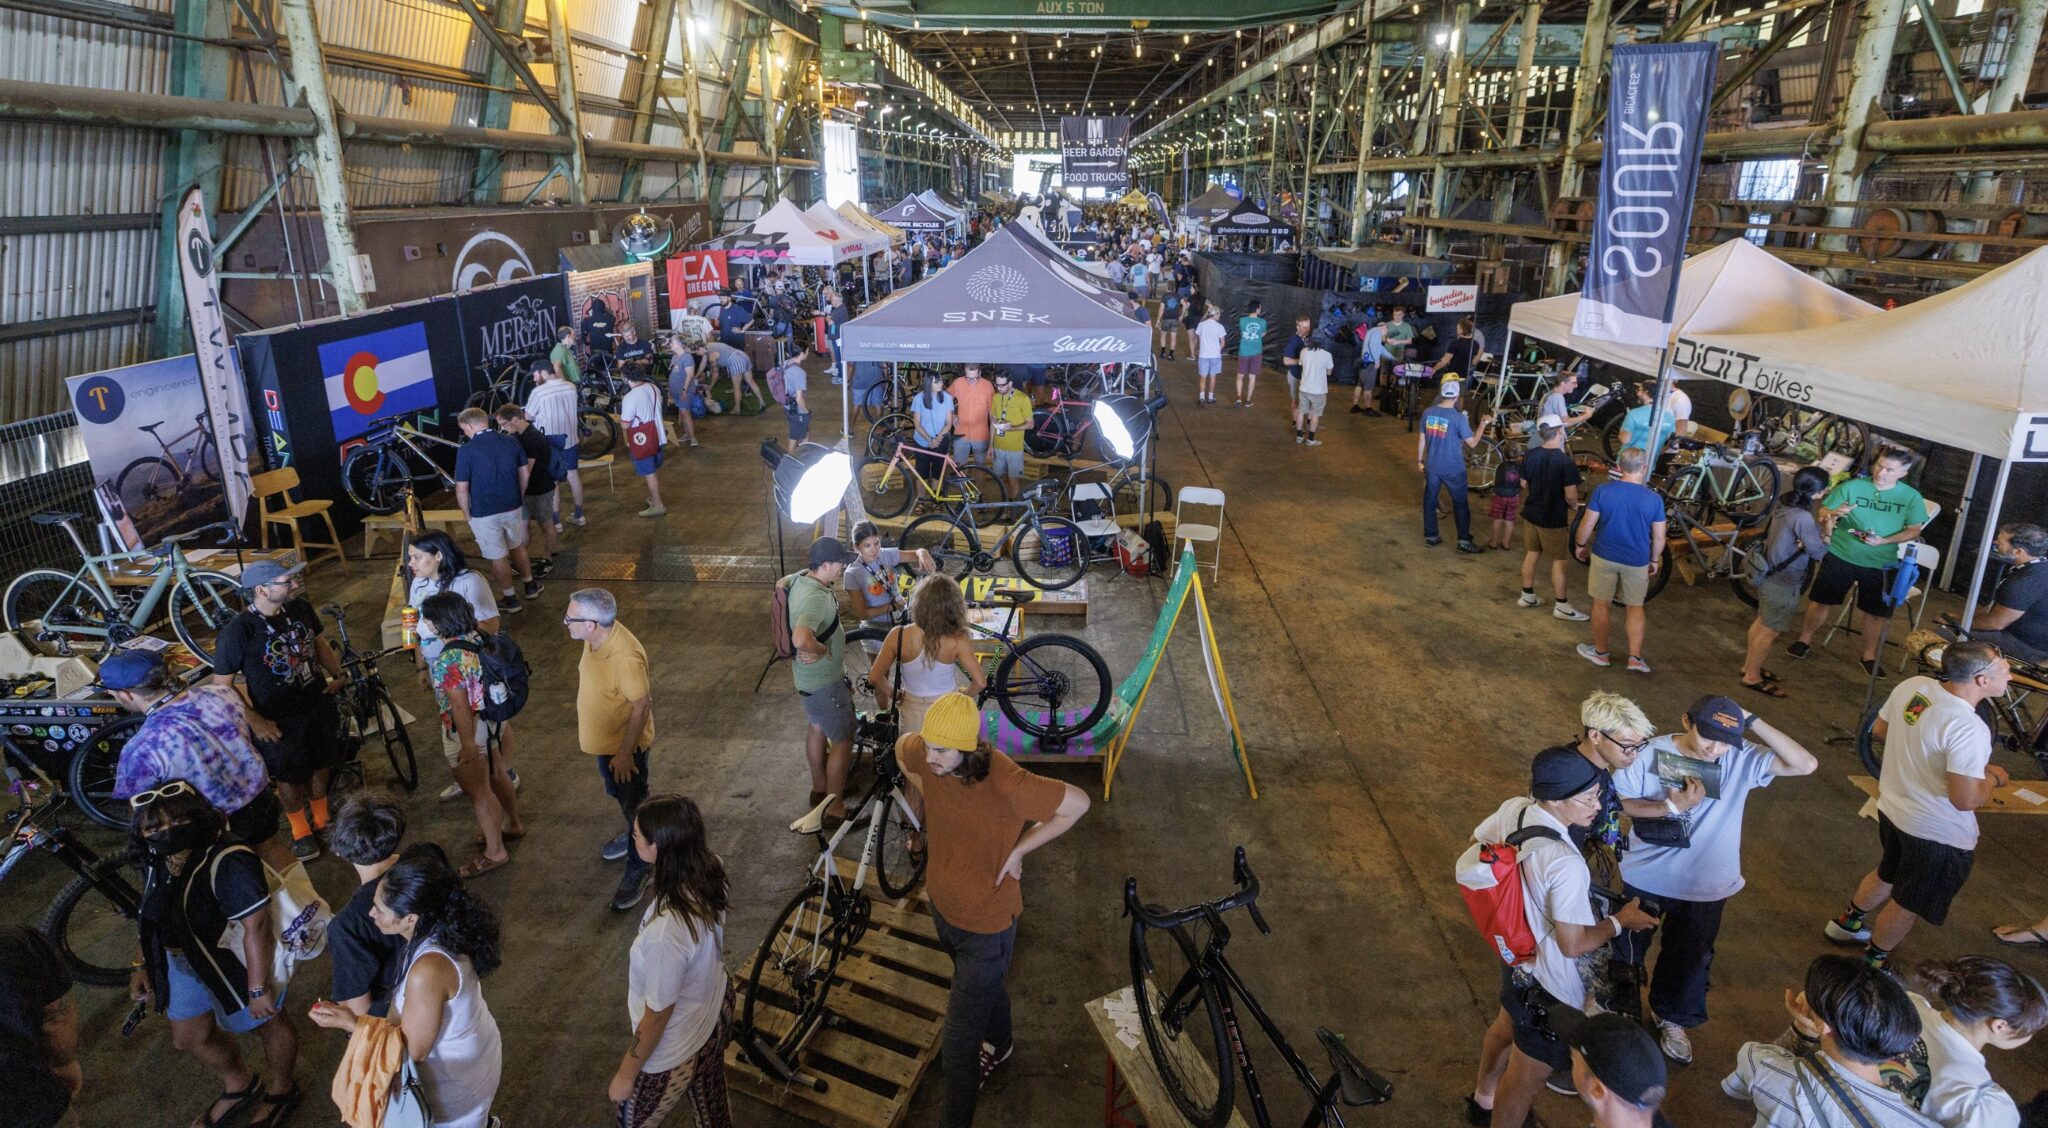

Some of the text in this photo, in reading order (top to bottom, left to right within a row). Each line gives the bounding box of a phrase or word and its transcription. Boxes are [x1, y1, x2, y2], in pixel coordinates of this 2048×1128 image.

[1036, 2, 1104, 14] AUX 5 TON
[1064, 147, 1127, 157] BEER GARDEN
[1064, 172, 1126, 181] FOOD TRUCKS
[841, 243, 863, 254] VIRAL
[687, 279, 720, 294] OREGON
[1429, 289, 1463, 305] buendia
[1442, 293, 1474, 308] bicycles
[480, 306, 557, 362] MERLIN
[1053, 335, 1133, 353] SaltAir
[130, 376, 196, 399] engineered
[1754, 367, 1814, 402] bikes
